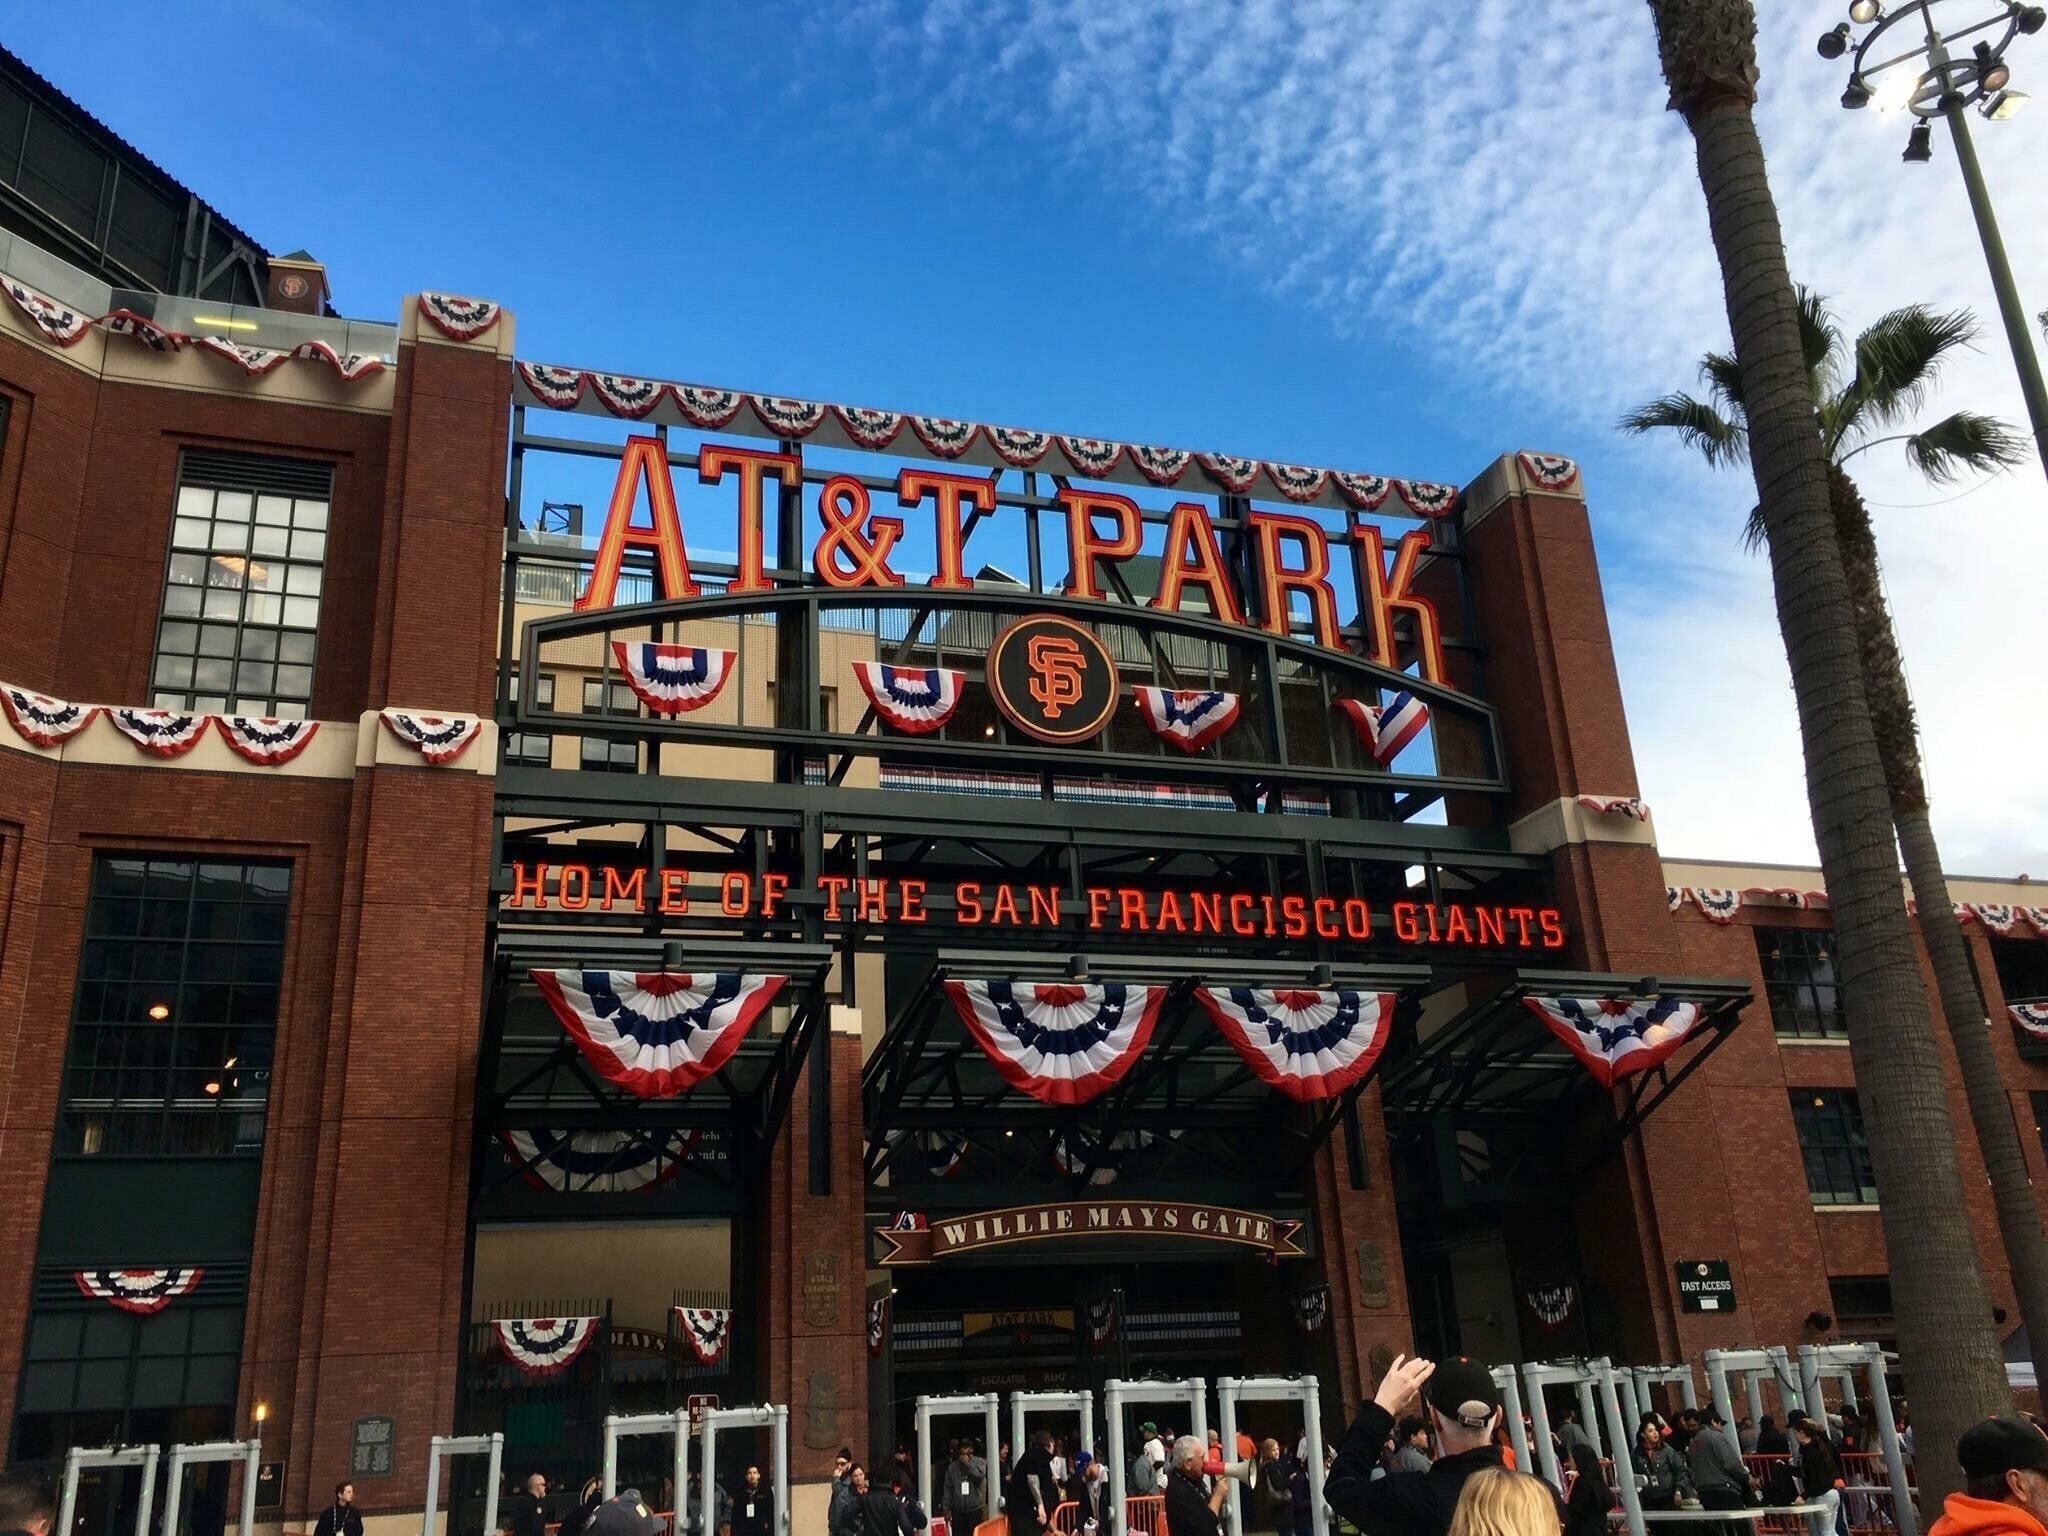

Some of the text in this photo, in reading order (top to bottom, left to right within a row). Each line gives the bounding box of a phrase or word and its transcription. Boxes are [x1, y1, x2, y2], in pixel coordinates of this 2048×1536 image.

[574, 434, 1456, 689] AT&T PARK
[1027, 634, 1088, 719] SF
[509, 859, 1565, 949] HOME OF THE SAN FRANCISCO GIANTS
[941, 1207, 1271, 1246] WILLIE MAYS GATE
[1680, 1280, 1732, 1292] FAST ACCESS
[981, 1374, 1026, 1385] ESCALATOR
